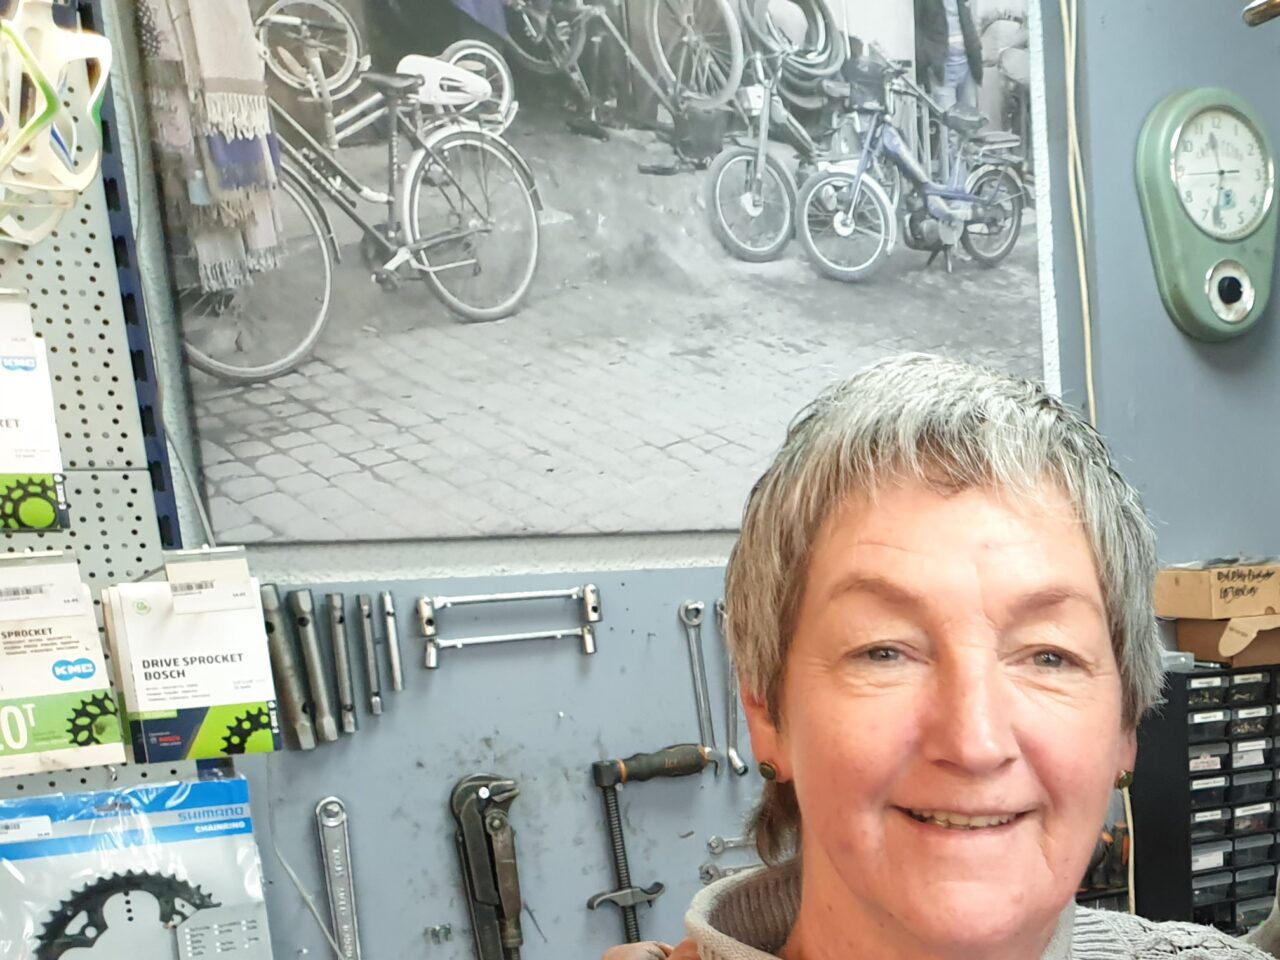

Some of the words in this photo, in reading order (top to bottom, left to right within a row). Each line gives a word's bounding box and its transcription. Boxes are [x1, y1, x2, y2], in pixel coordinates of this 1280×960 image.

[1195, 122, 1204, 135] 11
[1211, 116, 1222, 129] 12
[1183, 140, 1193, 152] 10
[1247, 143, 1255, 156] 2
[1255, 168, 1261, 181] 3
[1185, 190, 1194, 203] 8
[1201, 209, 1209, 221] 7
[1238, 211, 1244, 224] 5
[1, 627, 54, 640] SPROCKET
[142, 656, 180, 670] DRIVE
[183, 653, 244, 667] SPROCKET
[53, 663, 94, 677] KMC
[144, 668, 186, 681] BOSCH
[0, 703, 36, 750] 0T
[177, 806, 245, 821] SHIMANO
